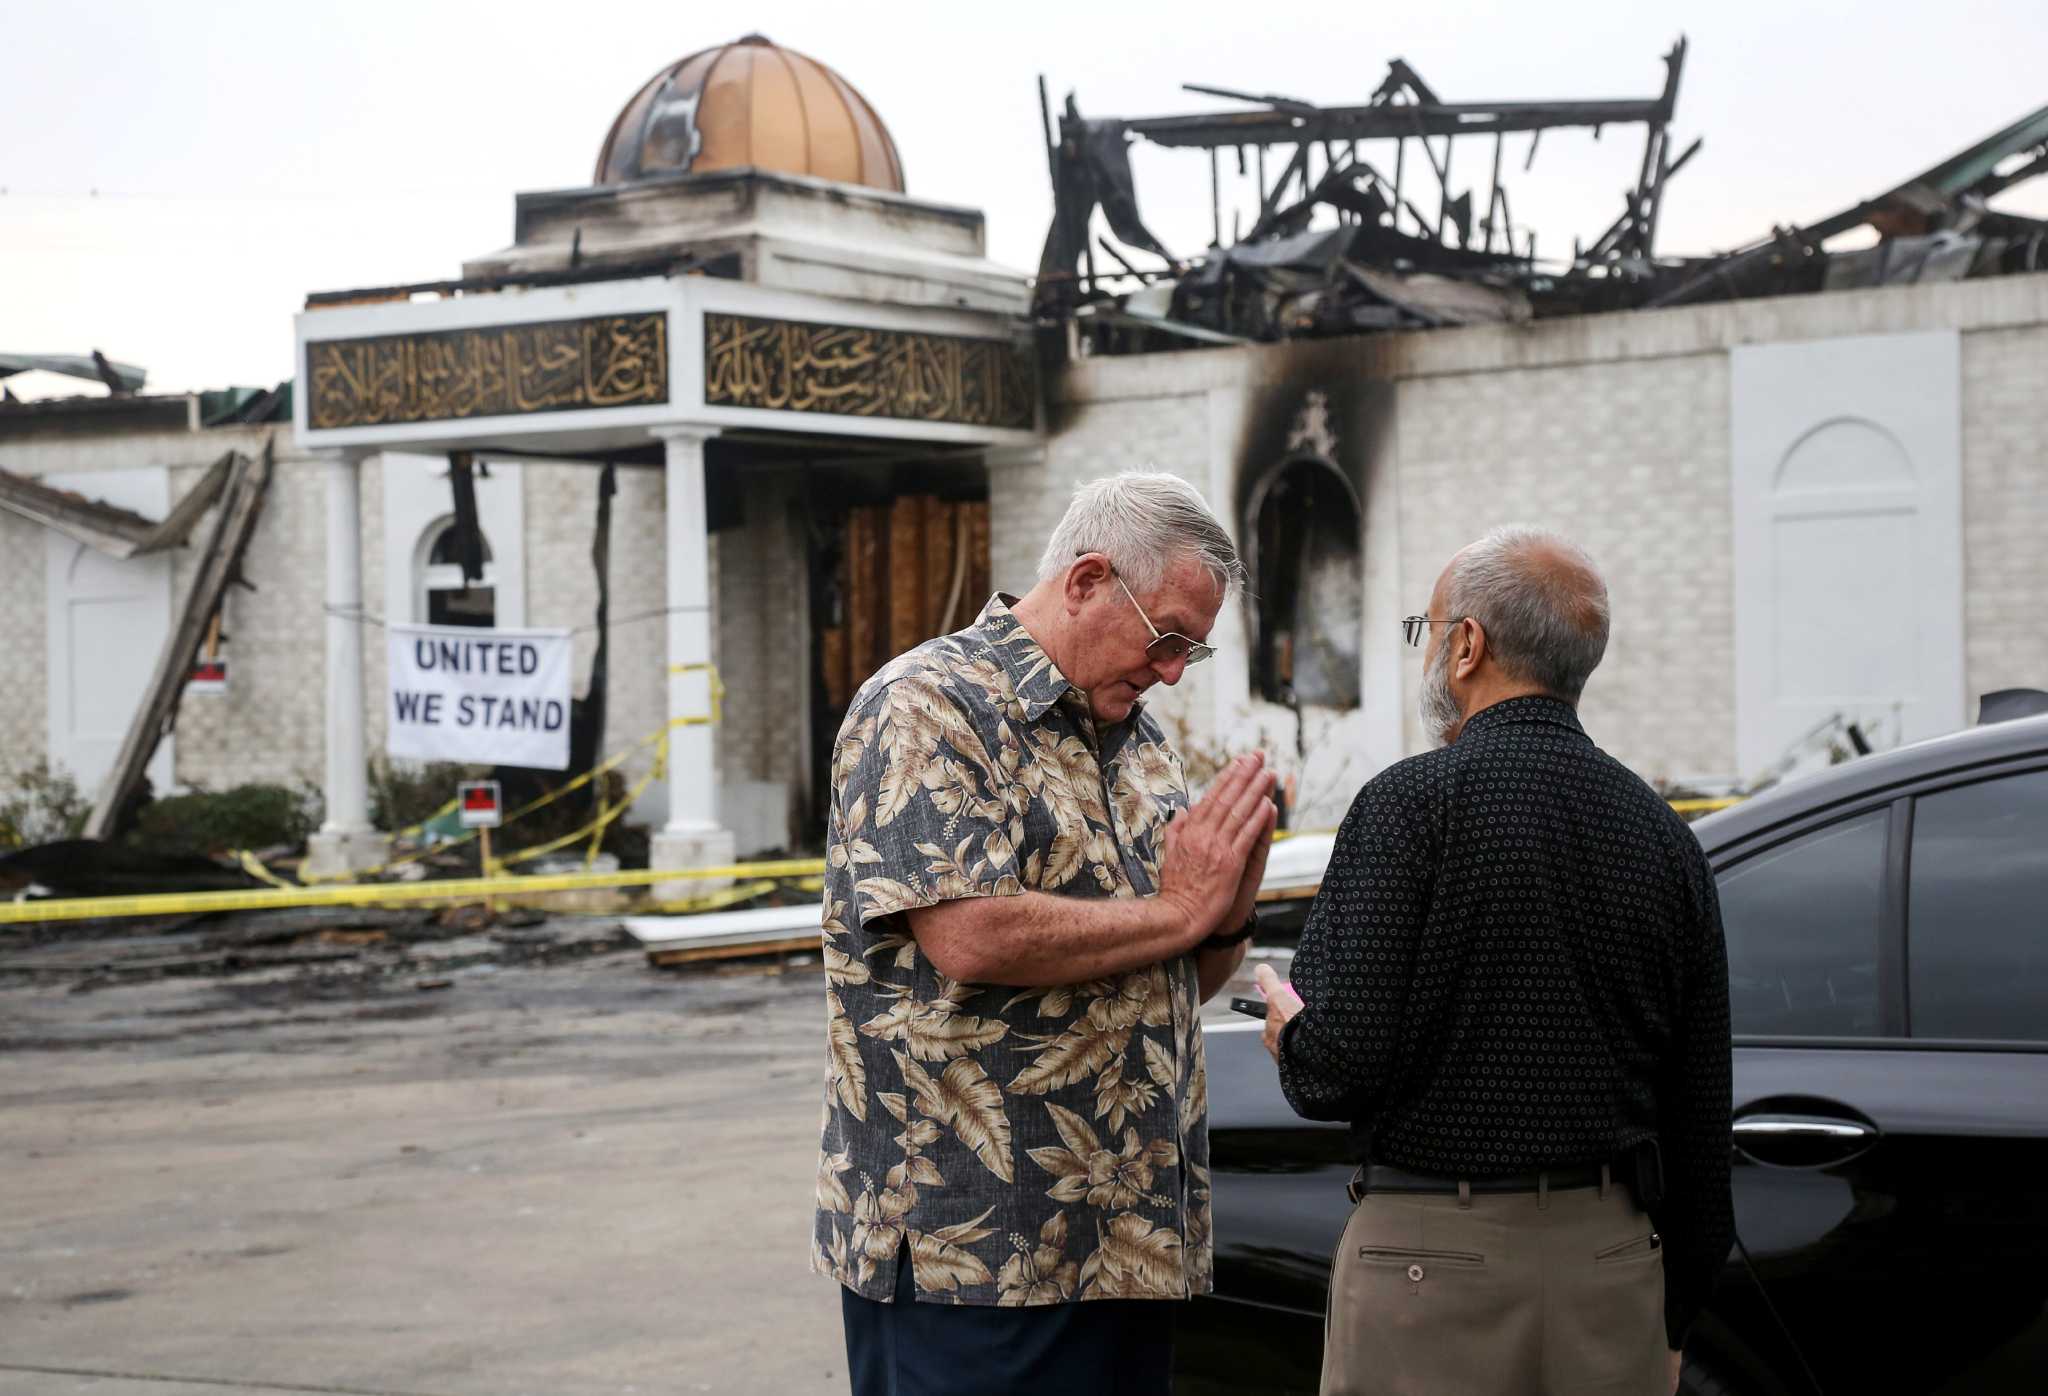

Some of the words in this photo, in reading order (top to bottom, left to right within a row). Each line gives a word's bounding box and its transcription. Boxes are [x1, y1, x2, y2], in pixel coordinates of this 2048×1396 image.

[416, 638, 538, 675] UNITED
[395, 691, 442, 724] WE
[456, 696, 563, 731] STAND
